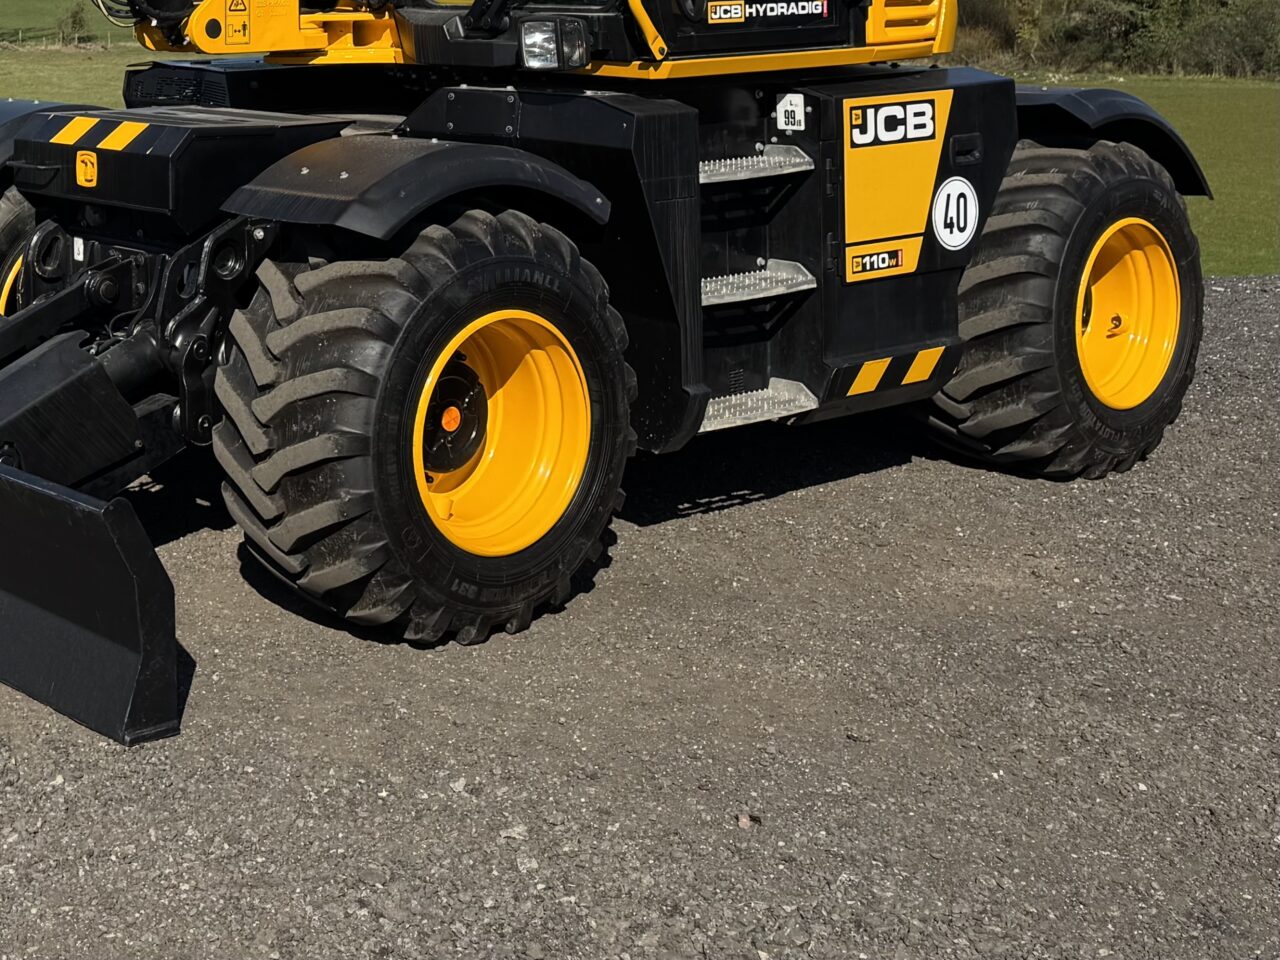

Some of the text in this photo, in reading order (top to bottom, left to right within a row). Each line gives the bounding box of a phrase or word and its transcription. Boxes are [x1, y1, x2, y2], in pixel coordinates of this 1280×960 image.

[711, 1, 823, 19] JCB HYDRADIG
[784, 109, 796, 126] 99
[851, 102, 934, 145] JCB
[943, 191, 968, 235] 40
